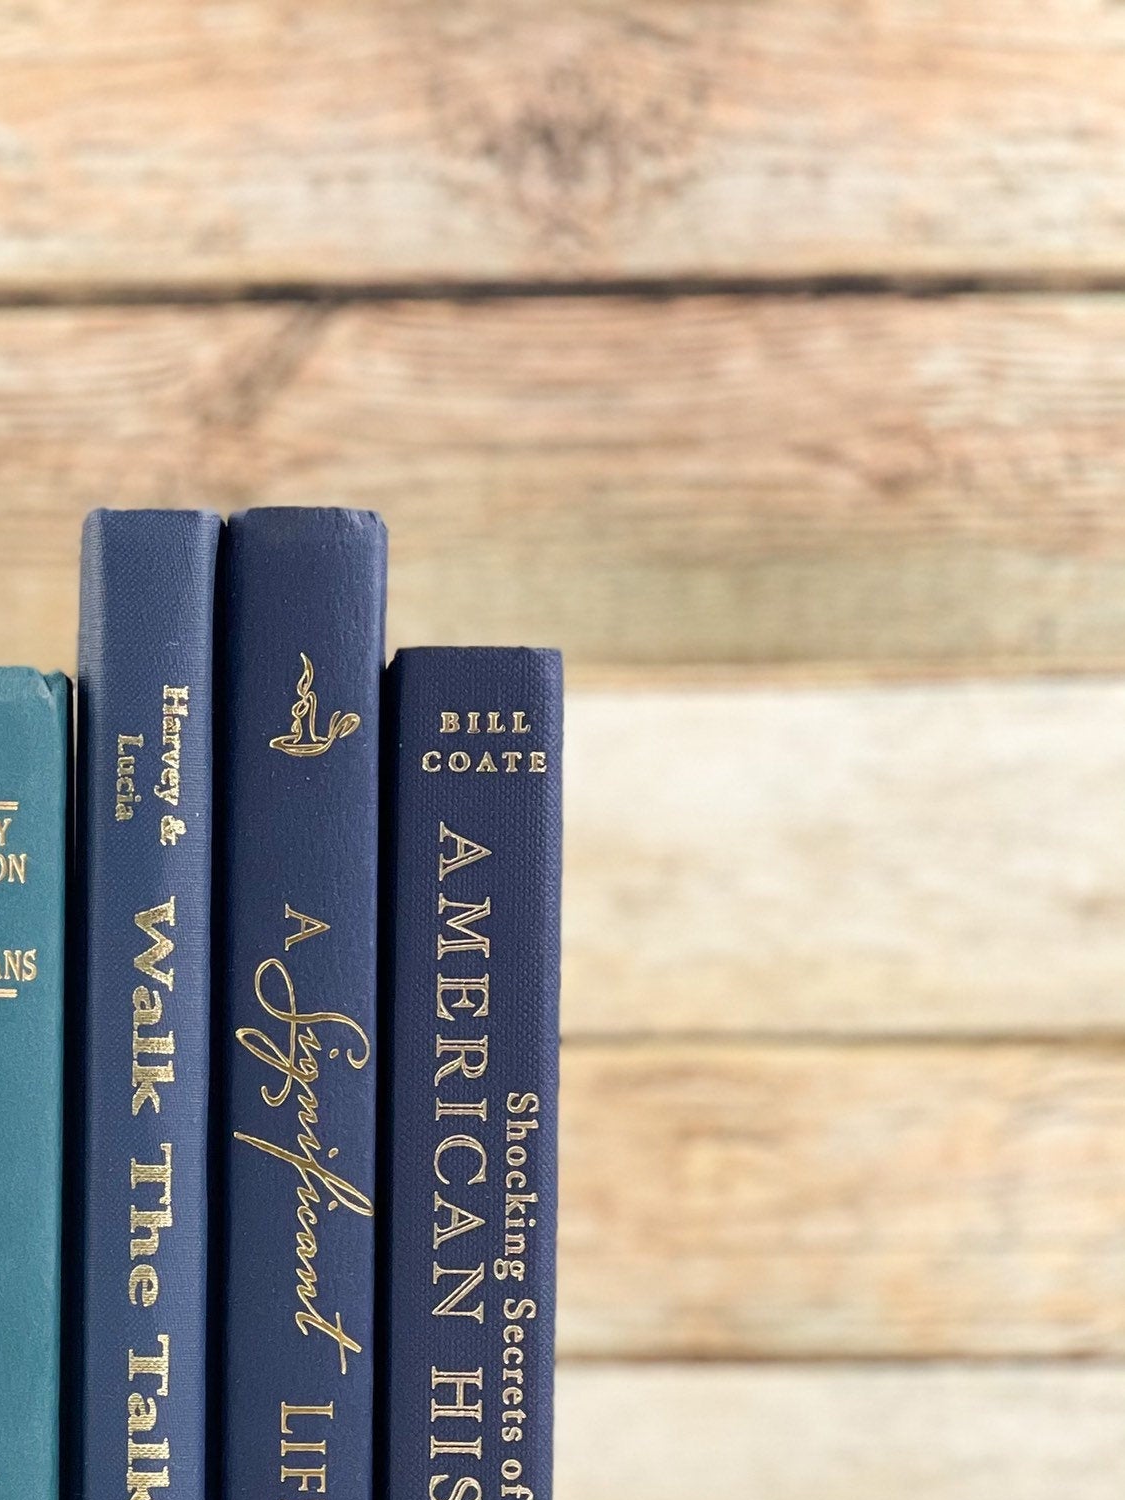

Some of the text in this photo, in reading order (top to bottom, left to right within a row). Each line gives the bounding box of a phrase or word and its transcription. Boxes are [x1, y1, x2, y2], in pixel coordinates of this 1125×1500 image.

[115, 734, 143, 821] Lucia
[154, 685, 189, 846] Harvey &
[422, 751, 547, 772] COATE
[440, 712, 531, 733] BILL
[132, 896, 175, 1115] Walk
[285, 903, 330, 951] A
[431, 821, 492, 1324] AMERICAN
[129, 1143, 173, 1307] The
[234, 958, 374, 1375] Significant
[494, 1093, 539, 1281] Shocking
[502, 1299, 536, 1441] Secrets
